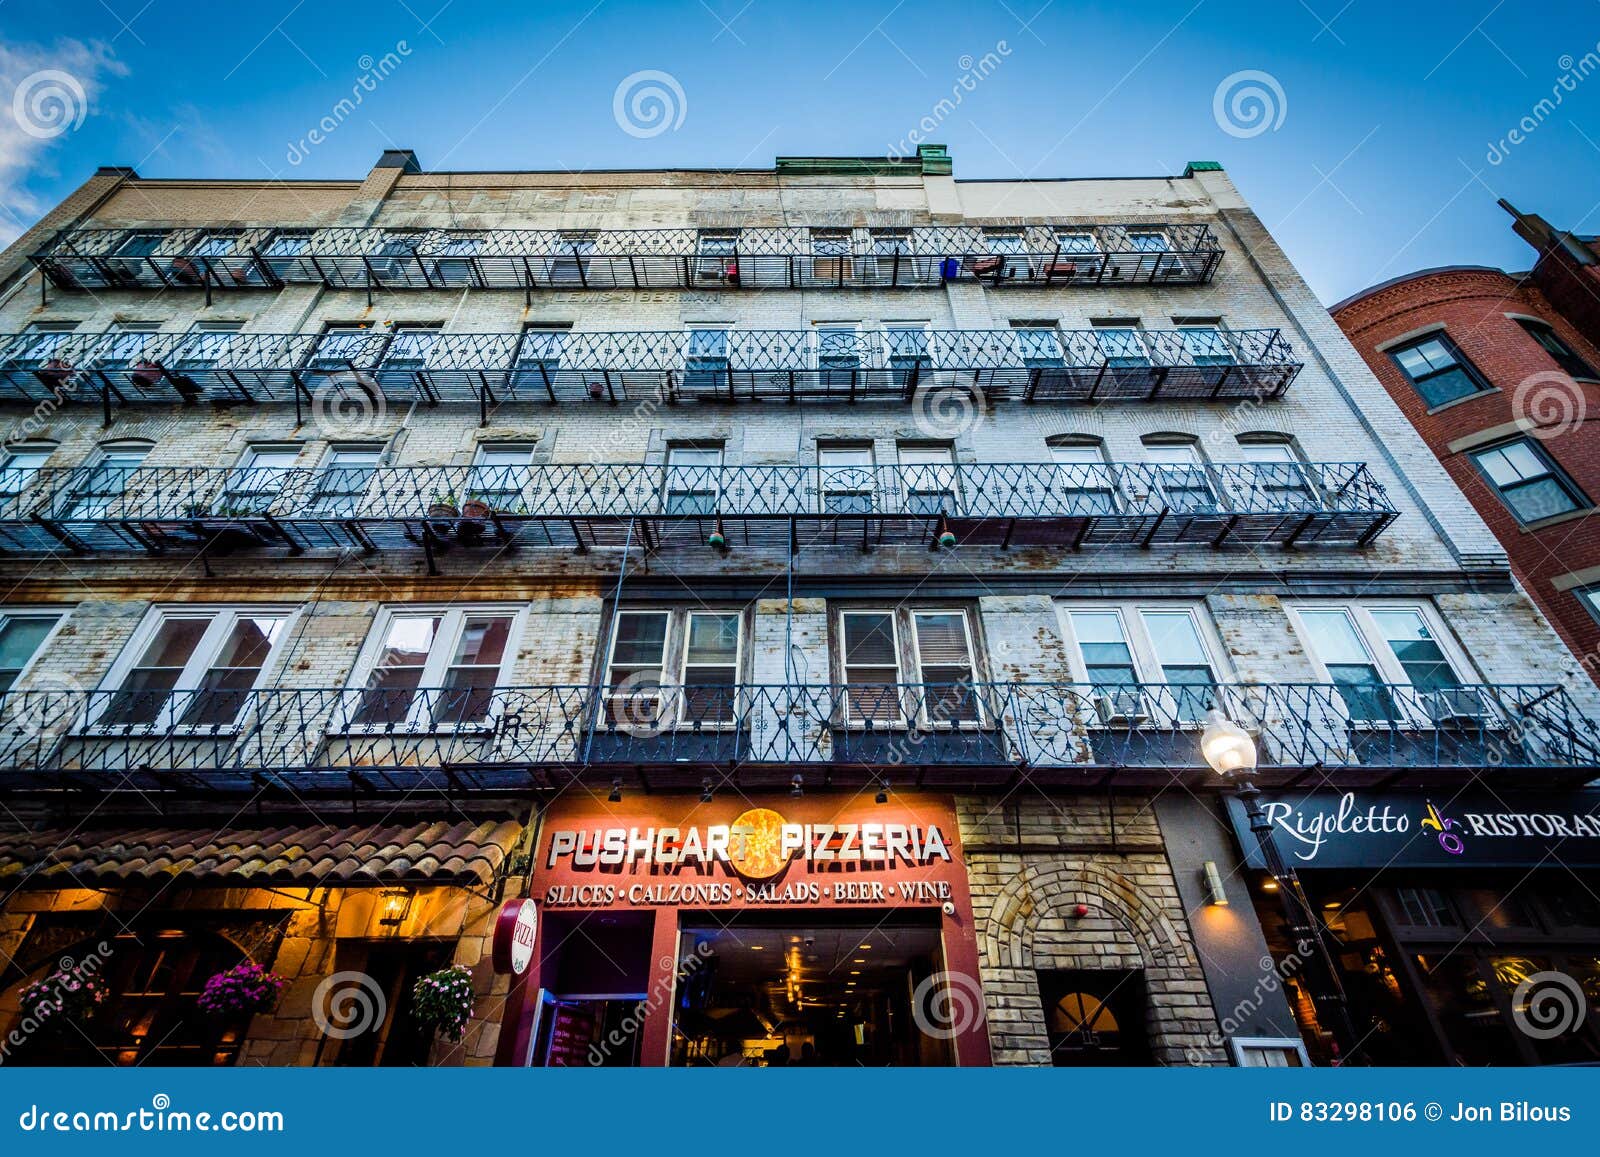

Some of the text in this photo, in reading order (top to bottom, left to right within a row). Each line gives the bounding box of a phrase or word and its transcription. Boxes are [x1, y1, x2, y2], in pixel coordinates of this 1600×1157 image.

[549, 823, 950, 866] PUSHCART PIZZERIA
[1261, 792, 1409, 861] Rigoletto
[547, 880, 951, 904] SLICES CALZONES SALADS BEER WINE
[514, 920, 535, 949] PIZZA
